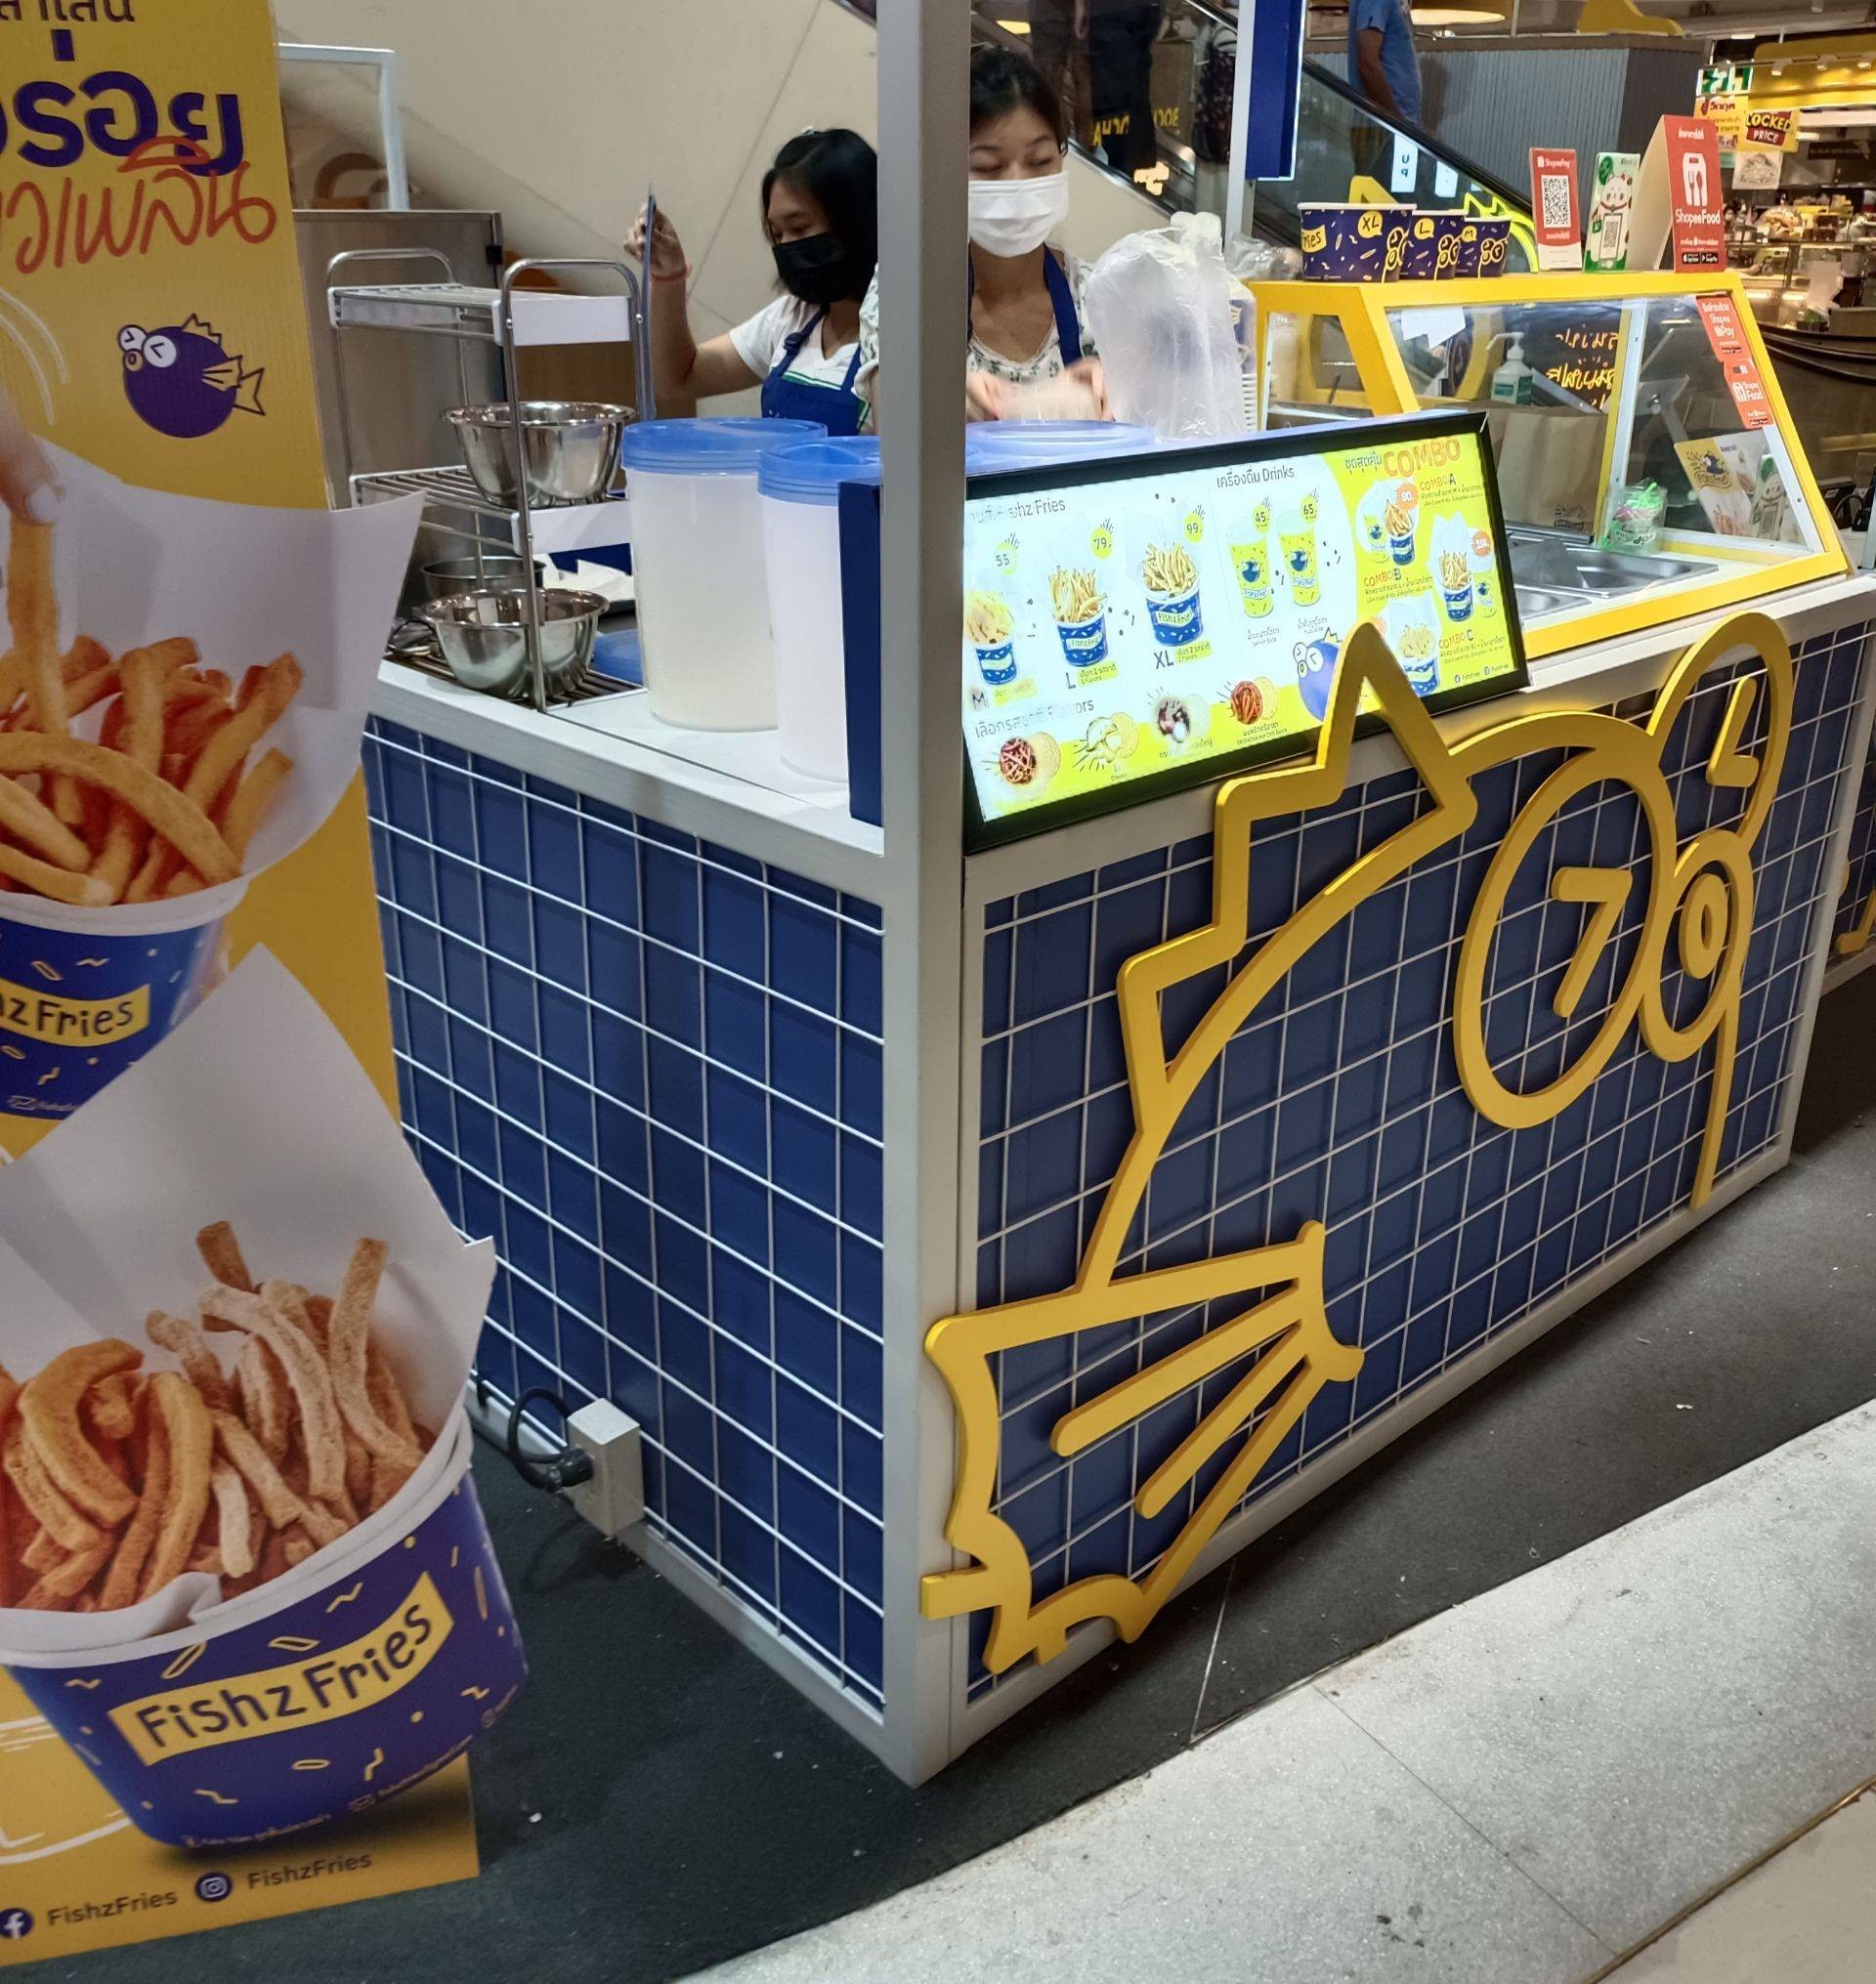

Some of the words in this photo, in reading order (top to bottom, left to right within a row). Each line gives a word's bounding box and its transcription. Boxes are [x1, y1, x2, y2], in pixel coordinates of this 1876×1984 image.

[0, 29, 244, 177] ร่อย
[1746, 112, 1792, 132] LOCKED
[1753, 130, 1780, 144] PRICE
[1362, 215, 1380, 232] XL
[1419, 222, 1431, 234] L
[1676, 208, 1721, 229] ShopeeFood
[1465, 230, 1474, 238] M
[1747, 391, 1764, 401] Food
[1384, 438, 1461, 477] COMBO
[1216, 467, 1260, 488] เครื่องดื่ม
[1262, 465, 1295, 483] Drinks
[1420, 477, 1449, 491] COMBO
[1449, 473, 1457, 485] A
[1035, 496, 1066, 515] Fries
[1363, 571, 1393, 588] COMBO
[1393, 569, 1402, 581] B
[1438, 632, 1467, 649] COMBO
[1467, 629, 1474, 642] C
[1153, 650, 1174, 669] XL
[1065, 672, 1076, 690] L
[971, 693, 987, 709] M
[135, 1603, 434, 1748] FishzFries
[247, 1852, 372, 1890] FishzFries
[47, 1887, 178, 1928] FishzFries
